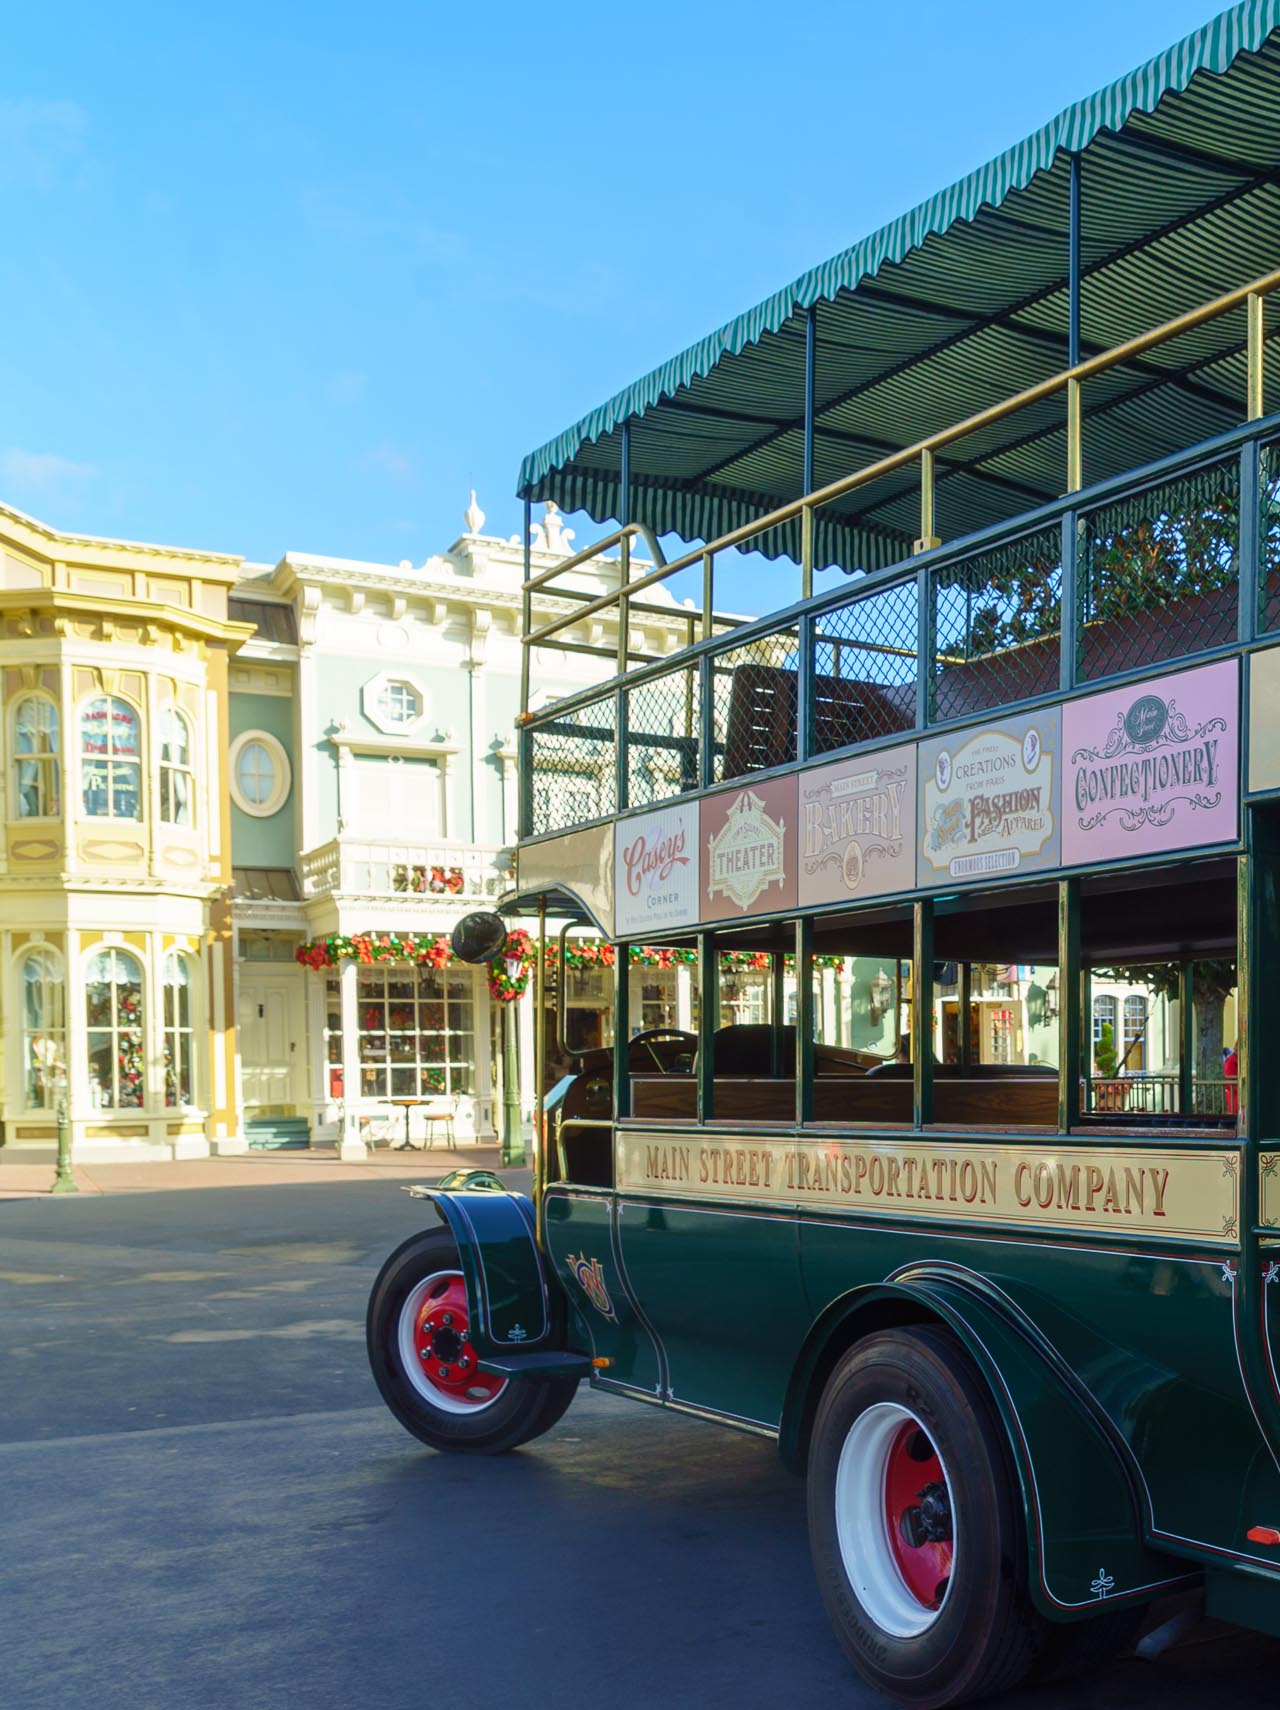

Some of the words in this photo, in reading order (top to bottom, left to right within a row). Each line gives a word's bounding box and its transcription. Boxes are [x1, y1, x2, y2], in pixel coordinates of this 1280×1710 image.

[955, 754, 1017, 779] CREATIONS
[1075, 740, 1219, 811] CONFECTIONERY
[804, 780, 907, 857] BAKERY
[965, 786, 1042, 844] FASHION
[1000, 816, 1045, 837] APPAREL
[623, 817, 691, 896] Casey's
[717, 843, 775, 875] THEATER
[647, 892, 679, 909] CORNER
[646, 1145, 690, 1181] MAIN
[700, 1147, 772, 1188] STREET
[784, 1150, 997, 1205] TRANSPORTATION
[1014, 1160, 1169, 1216] COMPANY
